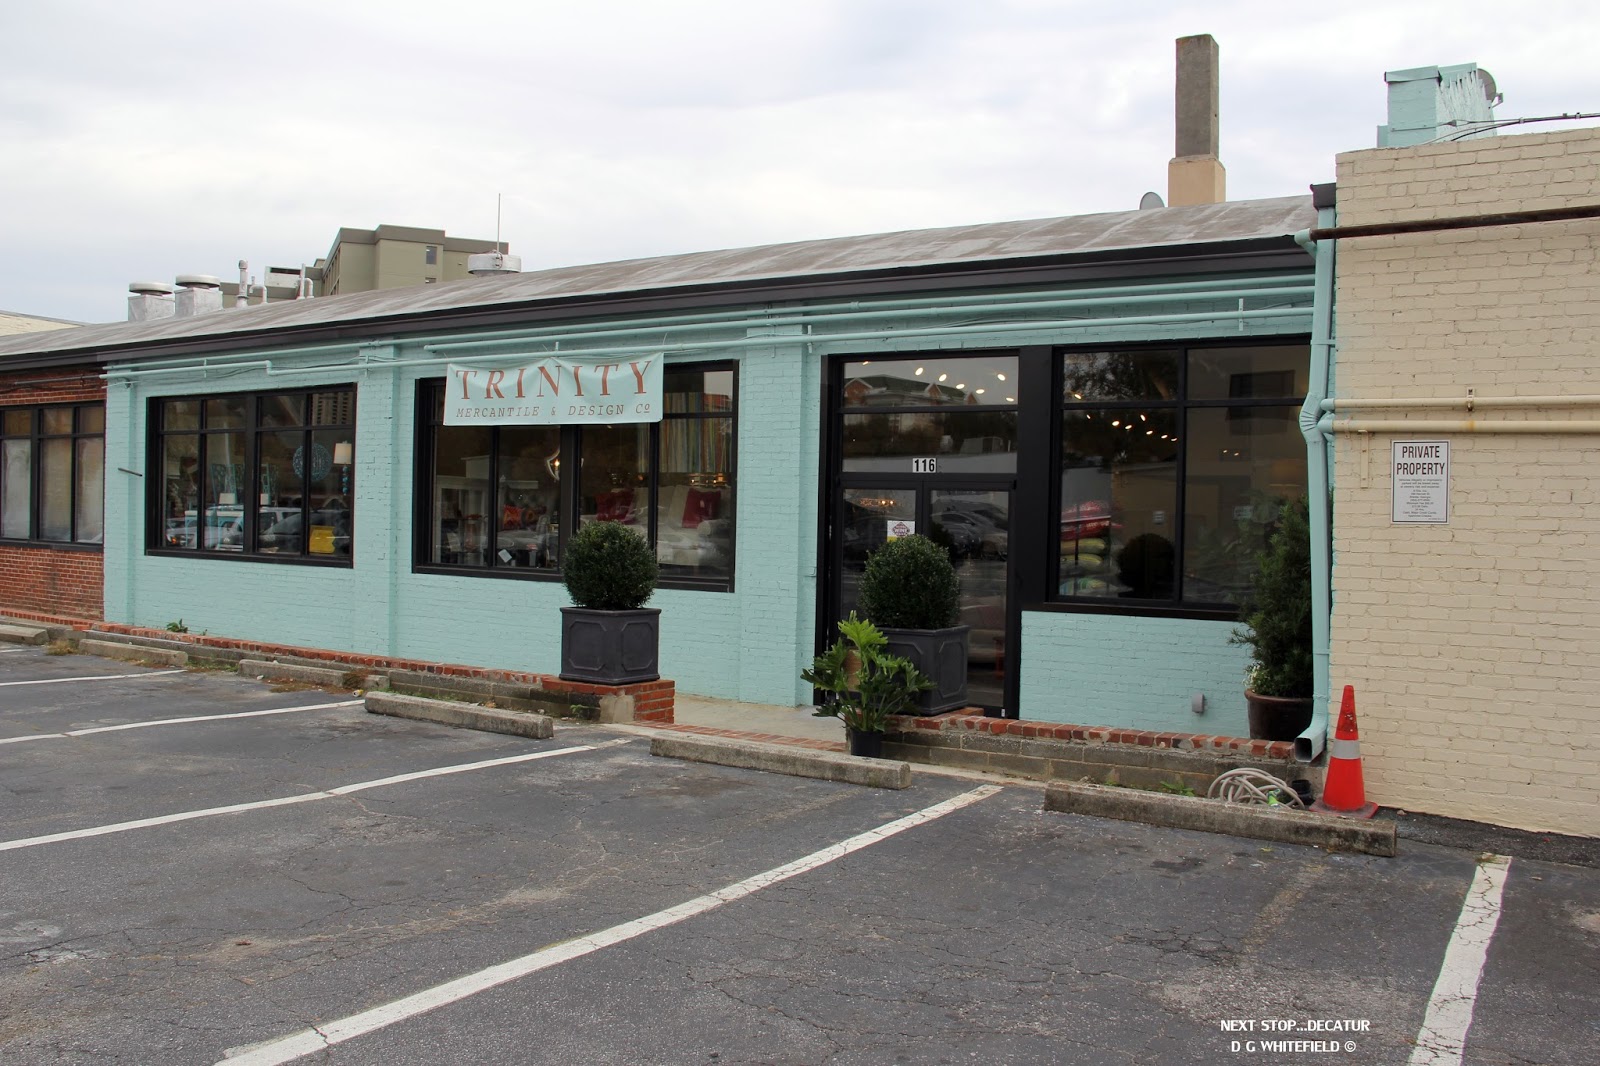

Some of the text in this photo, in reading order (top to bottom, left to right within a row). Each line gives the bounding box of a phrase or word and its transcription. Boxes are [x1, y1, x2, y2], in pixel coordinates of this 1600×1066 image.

[455, 360, 652, 400] TRINITY
[456, 406, 540, 418] MERCANTILE
[550, 406, 556, 416] &
[568, 404, 625, 416] DESIGN
[1402, 445, 1440, 458] PRIVATE
[914, 458, 935, 472] 116
[1396, 462, 1445, 475] PROPERTY
